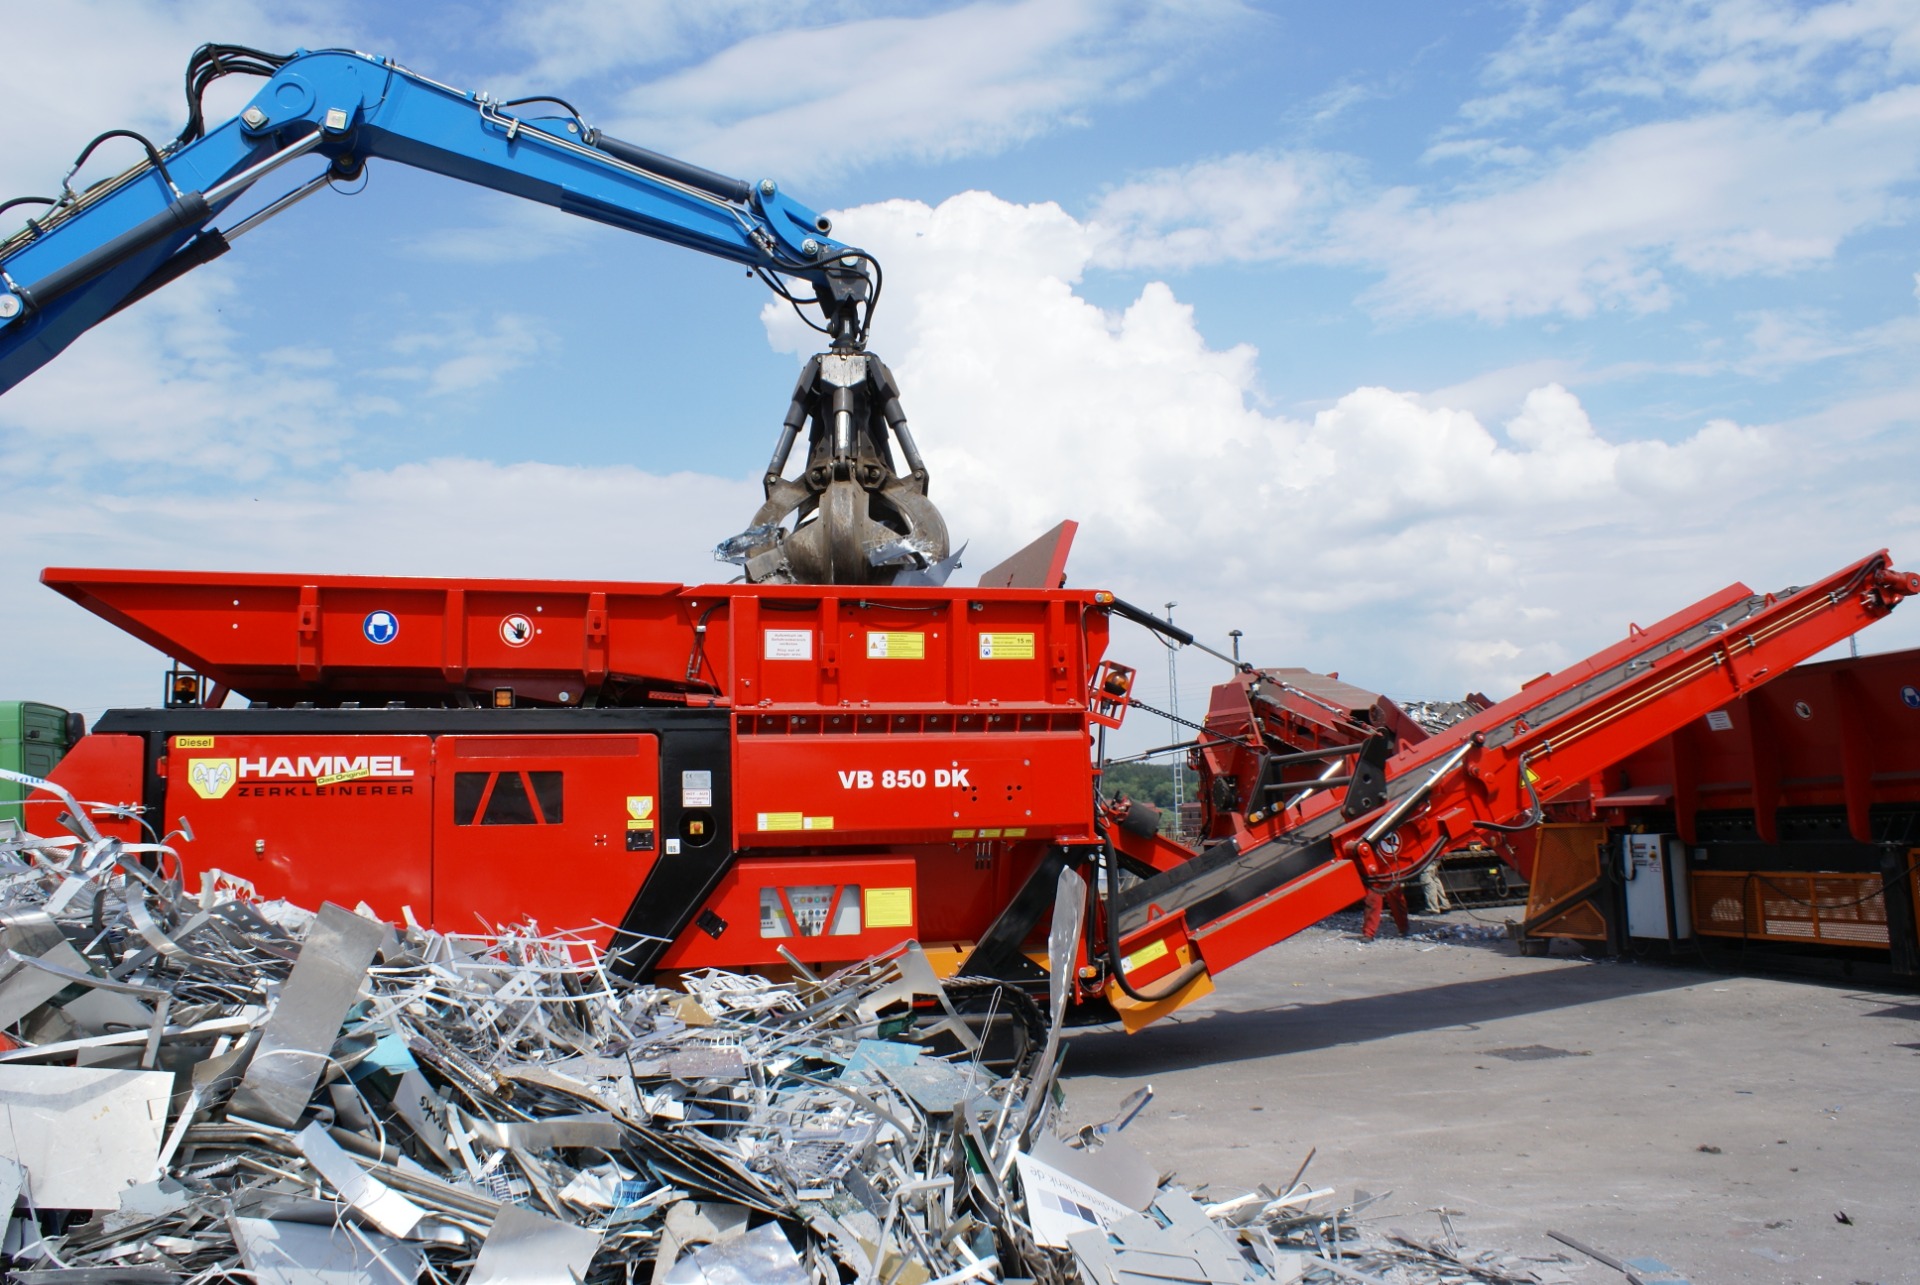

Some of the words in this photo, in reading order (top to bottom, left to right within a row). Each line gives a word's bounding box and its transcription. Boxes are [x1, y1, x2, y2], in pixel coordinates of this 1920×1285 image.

[179, 738, 211, 747] Diesel
[238, 756, 414, 777] HAMMEL
[335, 769, 368, 781] Original
[838, 770, 874, 789] VB
[881, 769, 926, 789] 850
[934, 769, 970, 788] DK
[238, 786, 413, 797] ZERKLEINERER
